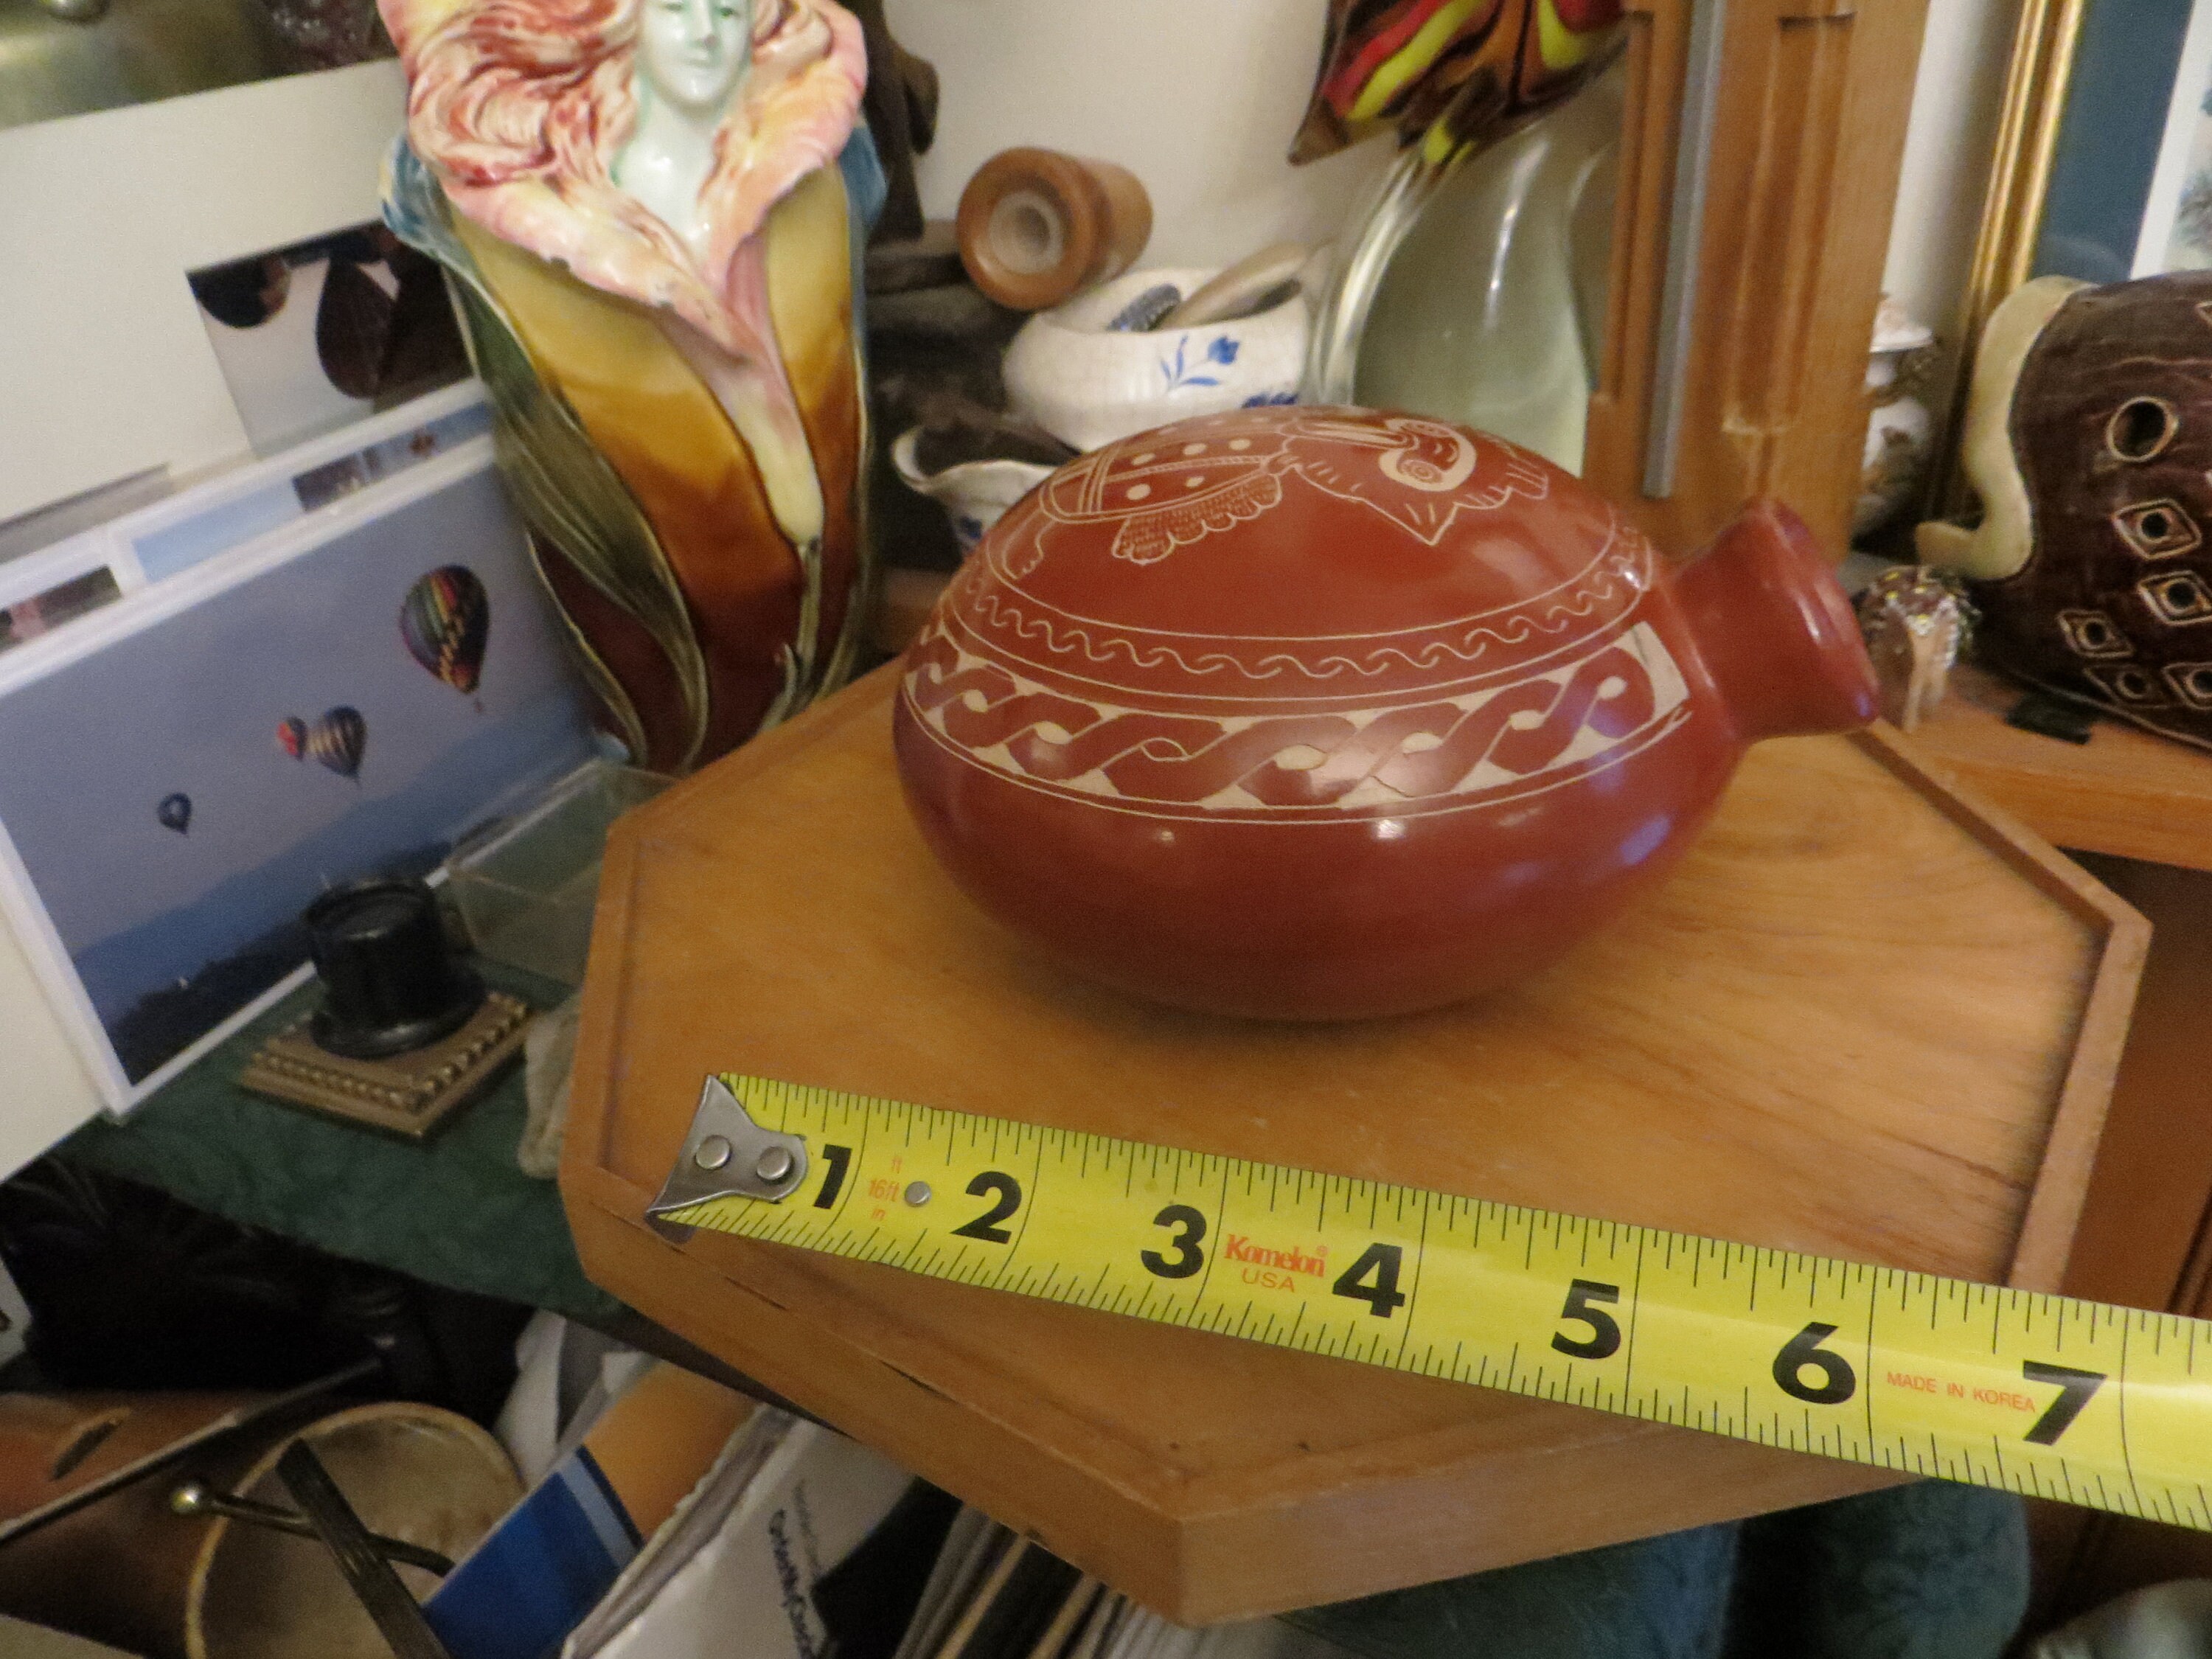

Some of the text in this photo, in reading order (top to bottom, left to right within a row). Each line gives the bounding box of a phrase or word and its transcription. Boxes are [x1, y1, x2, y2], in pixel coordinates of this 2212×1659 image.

[814, 1144, 852, 1209] 1
[950, 1171, 1022, 1244] 2
[1141, 1204, 1207, 1279] 3
[1242, 1268, 1295, 1293] USA
[1332, 1242, 1405, 1318] 4
[1551, 1278, 1621, 1360] 5
[1771, 1321, 1857, 1405] 6
[1888, 1371, 2036, 1413] MADE IN KOREA
[2023, 1360, 2107, 1446] 7
